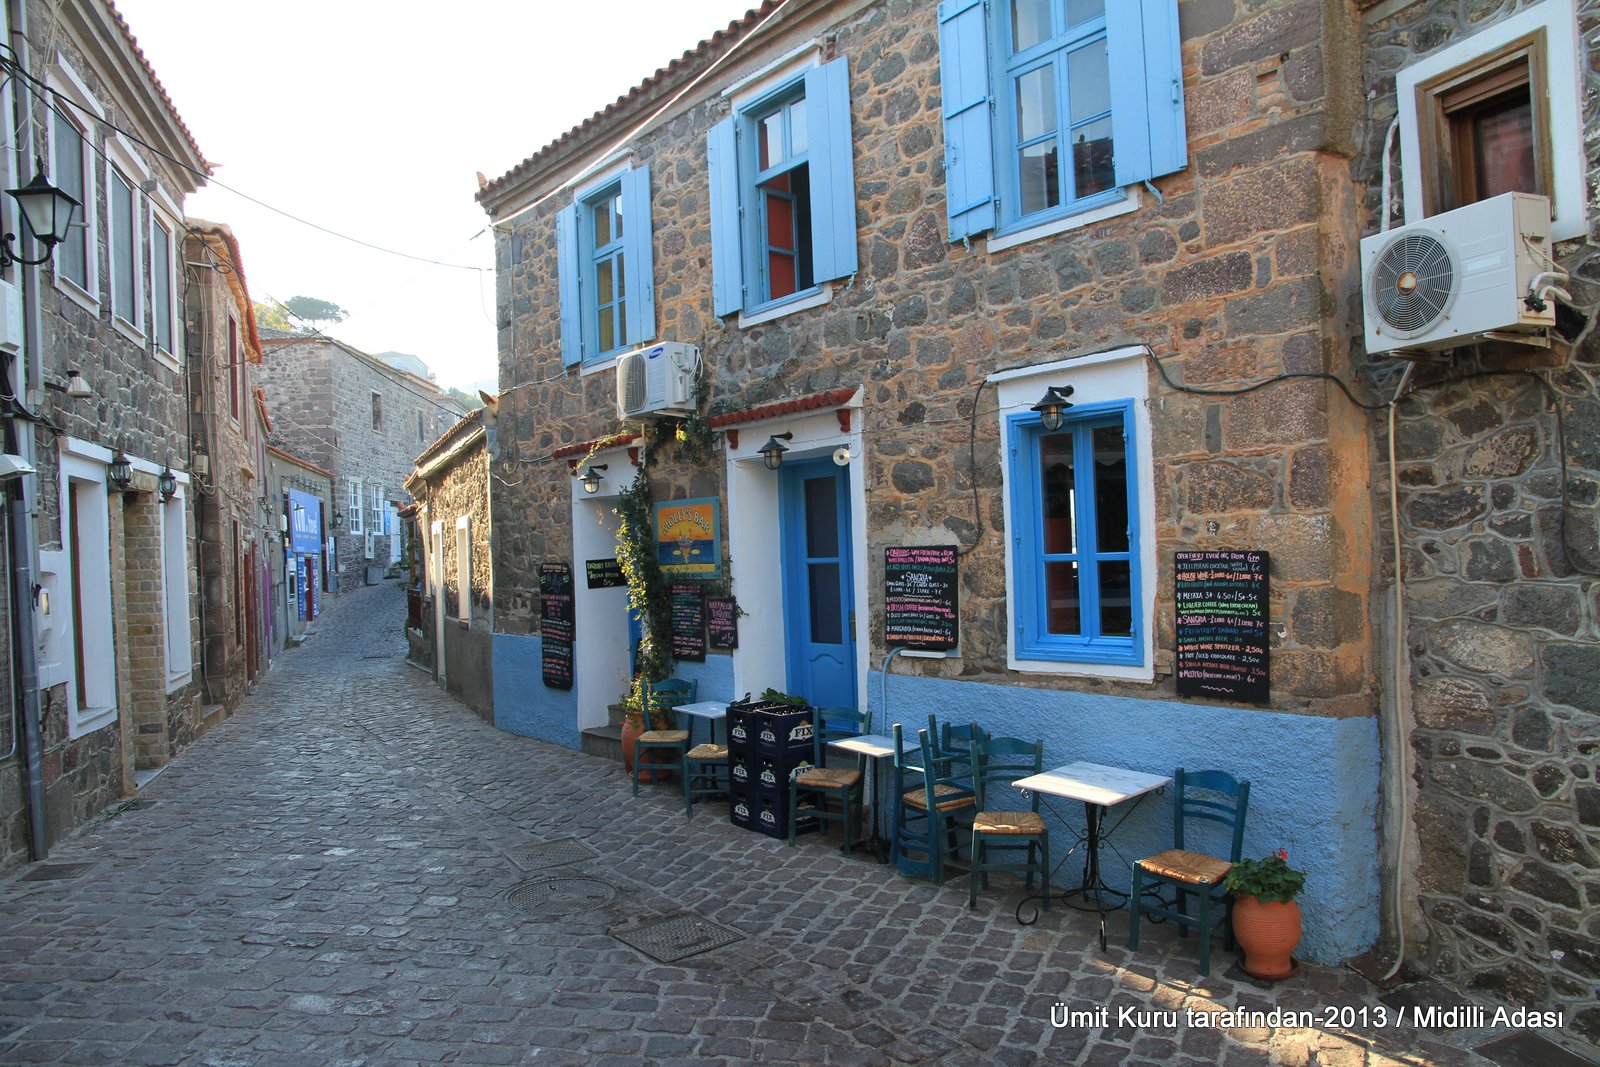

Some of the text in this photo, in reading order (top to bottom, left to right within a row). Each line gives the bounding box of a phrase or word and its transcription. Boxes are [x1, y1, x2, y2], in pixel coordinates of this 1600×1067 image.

[662, 509, 710, 536] MOLLY'S BAR
[795, 726, 813, 737] FIX
